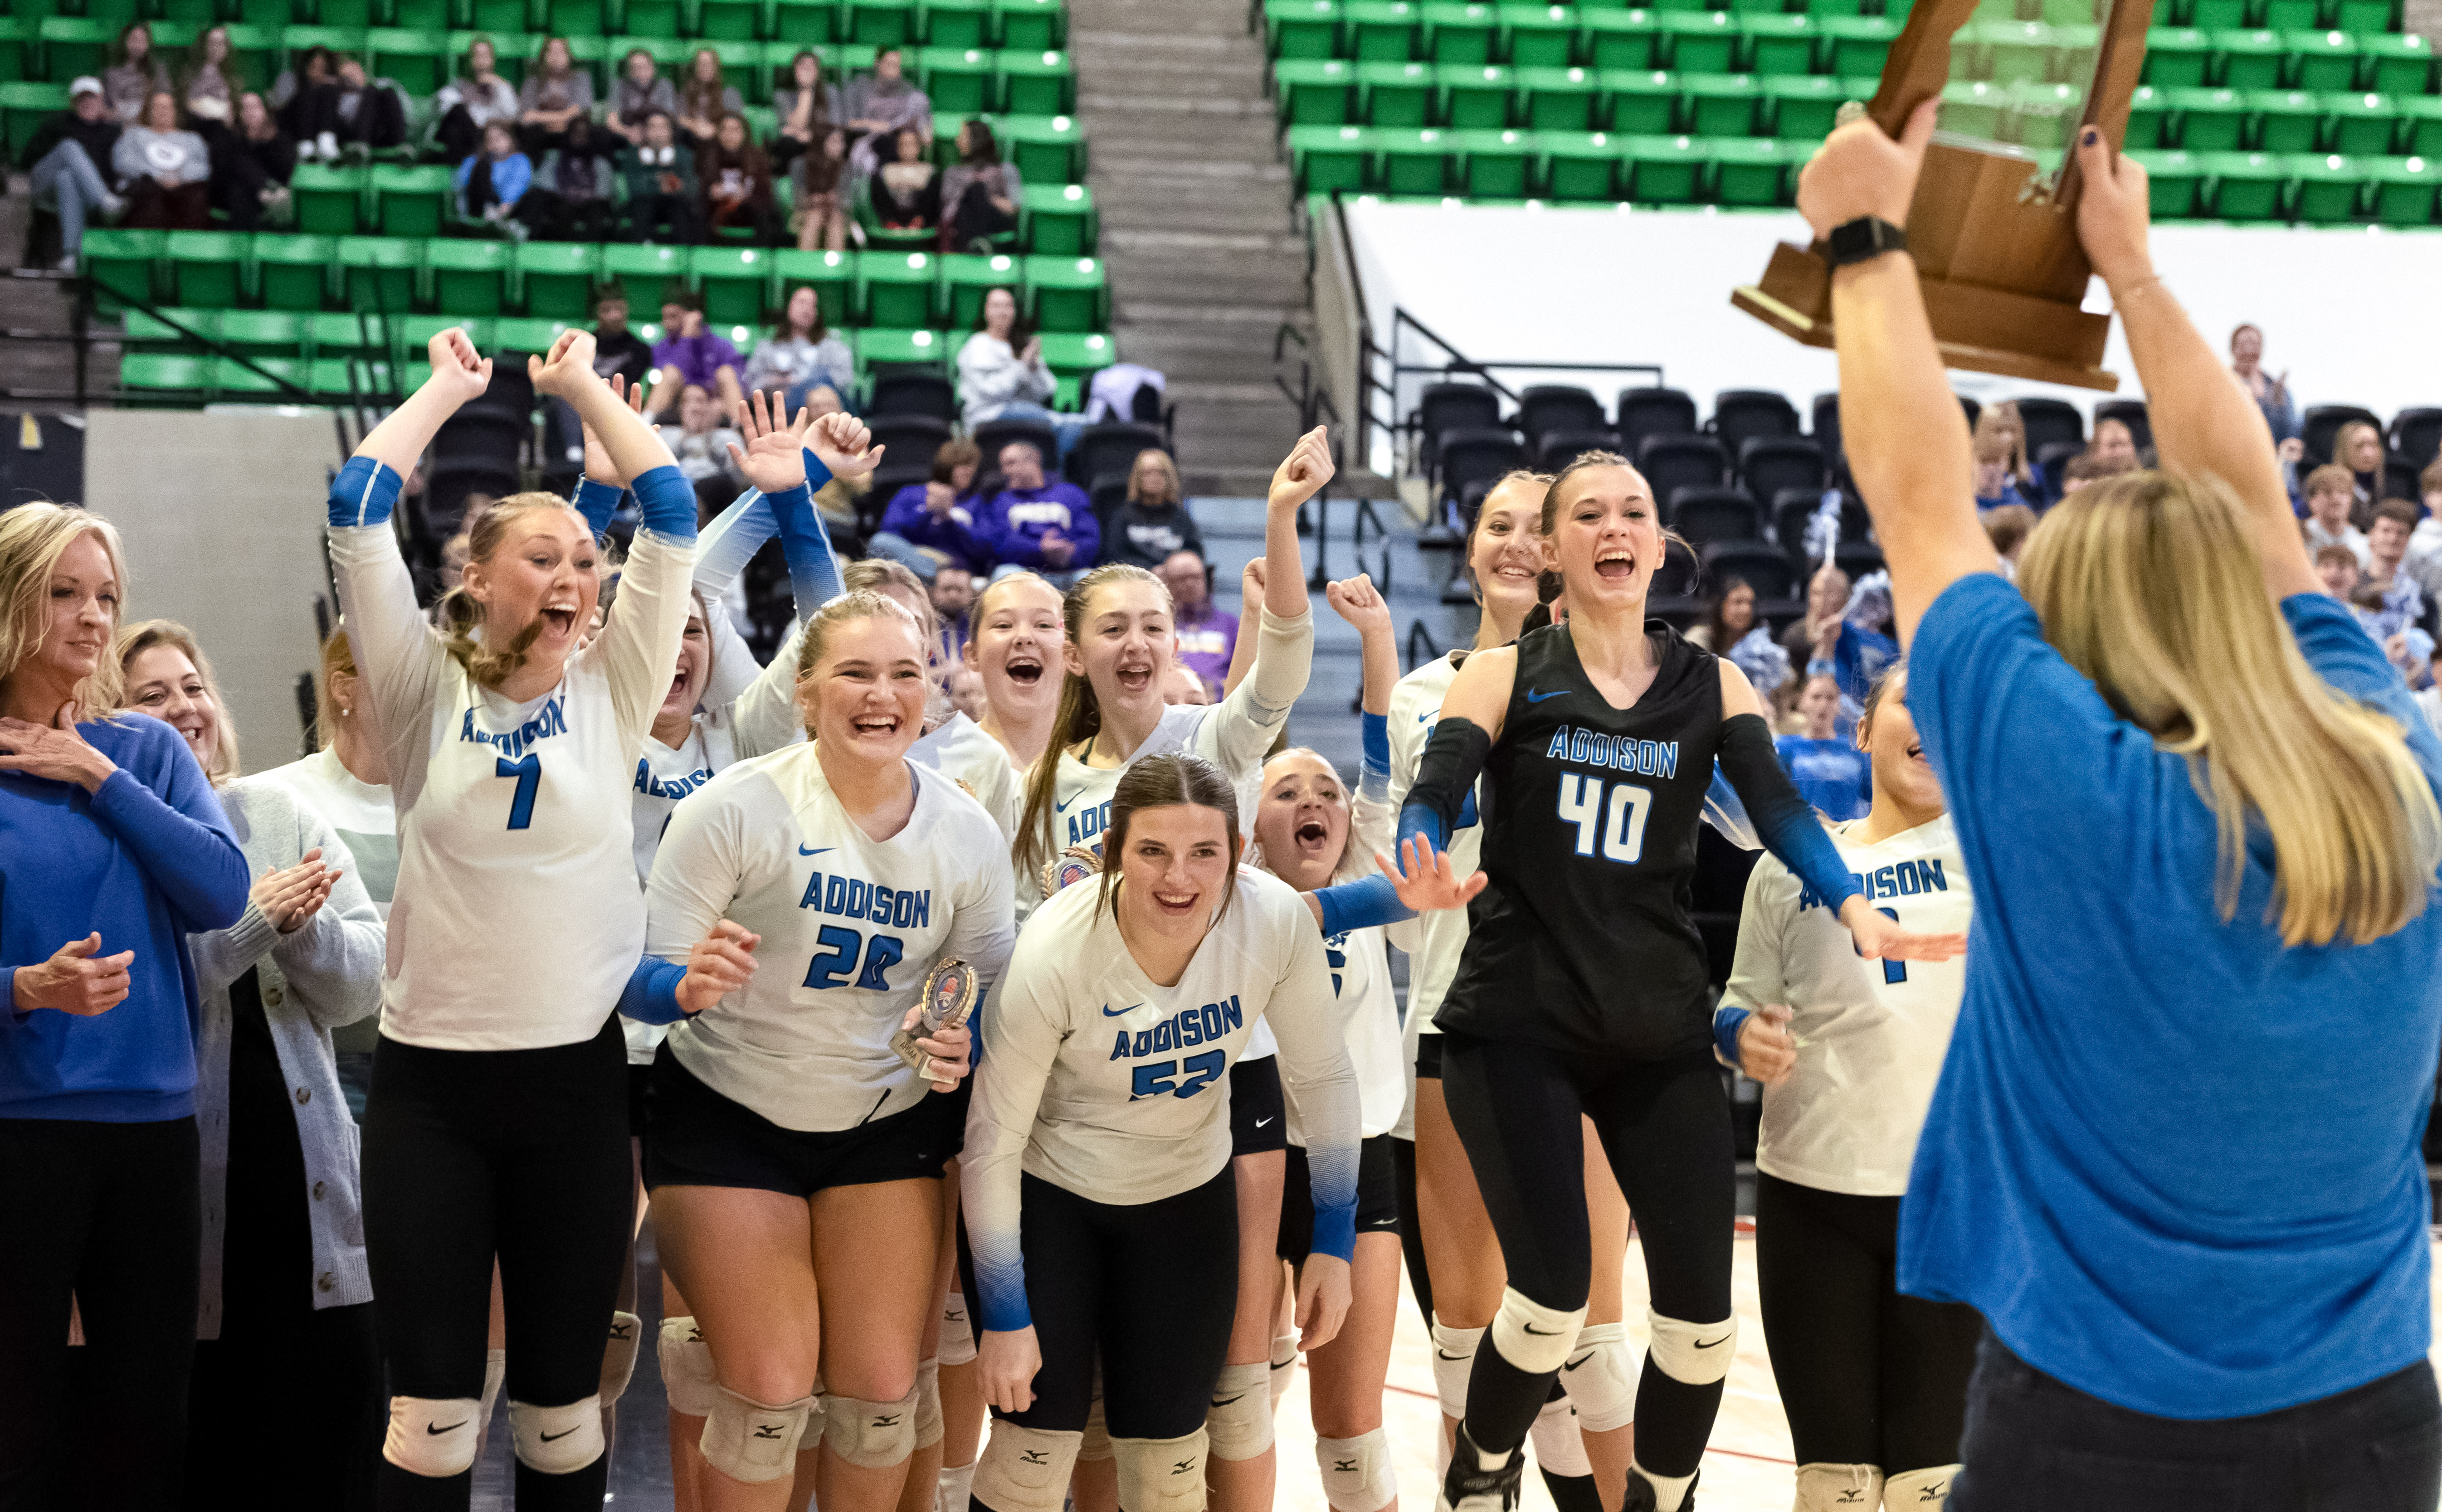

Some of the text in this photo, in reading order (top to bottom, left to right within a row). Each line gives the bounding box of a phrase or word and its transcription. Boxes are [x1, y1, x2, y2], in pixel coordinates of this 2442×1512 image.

[633, 758, 715, 800] ADDIS
[1546, 724, 1678, 779] ADDISON
[496, 752, 541, 831] 7
[1556, 771, 1654, 865] 40
[799, 871, 931, 928] ADDISON
[1799, 859, 1948, 912] AISON
[1109, 995, 1243, 1061] ADDISON
[1128, 1049, 1226, 1102] 52
